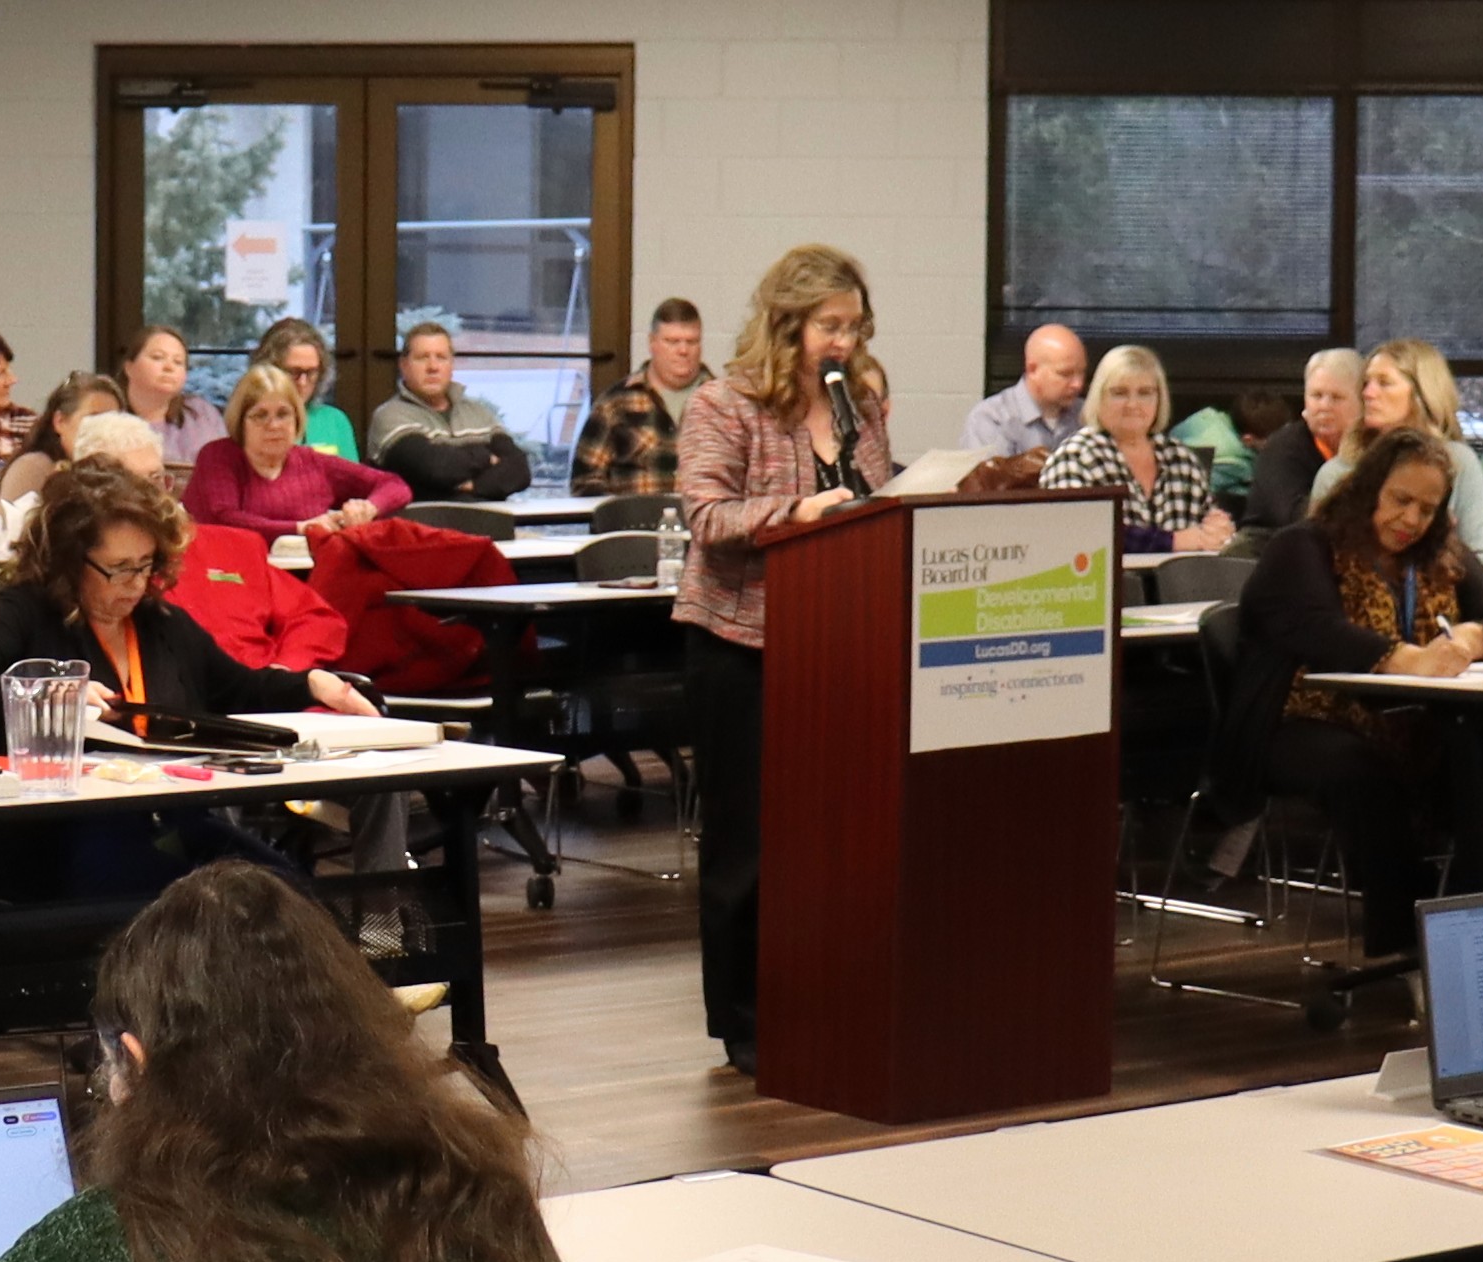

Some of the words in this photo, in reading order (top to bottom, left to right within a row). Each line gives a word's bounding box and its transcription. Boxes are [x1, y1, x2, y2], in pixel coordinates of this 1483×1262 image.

[922, 546, 969, 566] Lucas
[973, 543, 1029, 564] County
[922, 564, 969, 585] Board
[972, 562, 989, 581] of
[977, 582, 1096, 607] Developmental
[977, 609, 1062, 632] Disabilities
[975, 641, 1050, 658] LucasDD.org
[940, 678, 998, 699] inspiring
[1007, 673, 1083, 689] connections
